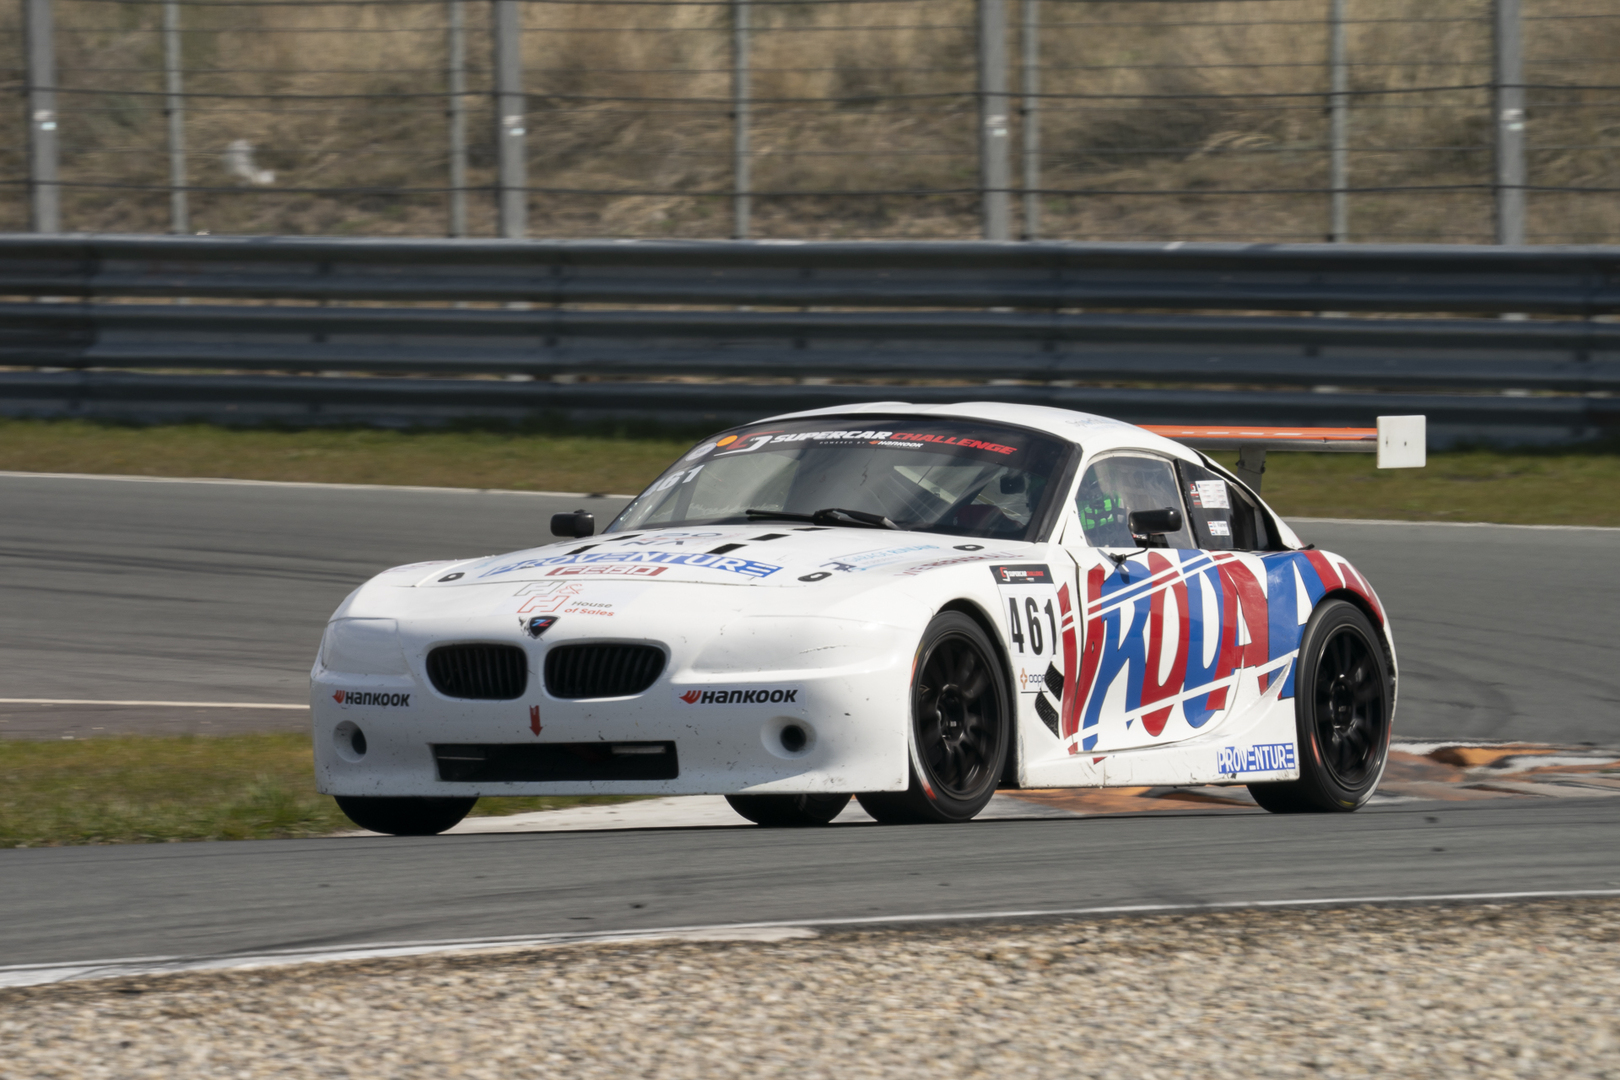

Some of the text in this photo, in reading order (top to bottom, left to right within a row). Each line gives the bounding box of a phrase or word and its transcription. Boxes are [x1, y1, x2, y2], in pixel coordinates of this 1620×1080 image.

[769, 430, 1018, 455] SUPERCAR CHALLENGE
[478, 550, 784, 578] PROVENTURE
[553, 565, 659, 576] FEBO
[571, 600, 613, 609] House
[579, 608, 615, 617] Sales
[1008, 596, 1057, 656] 461
[1217, 743, 1295, 774] PROVENTURE
